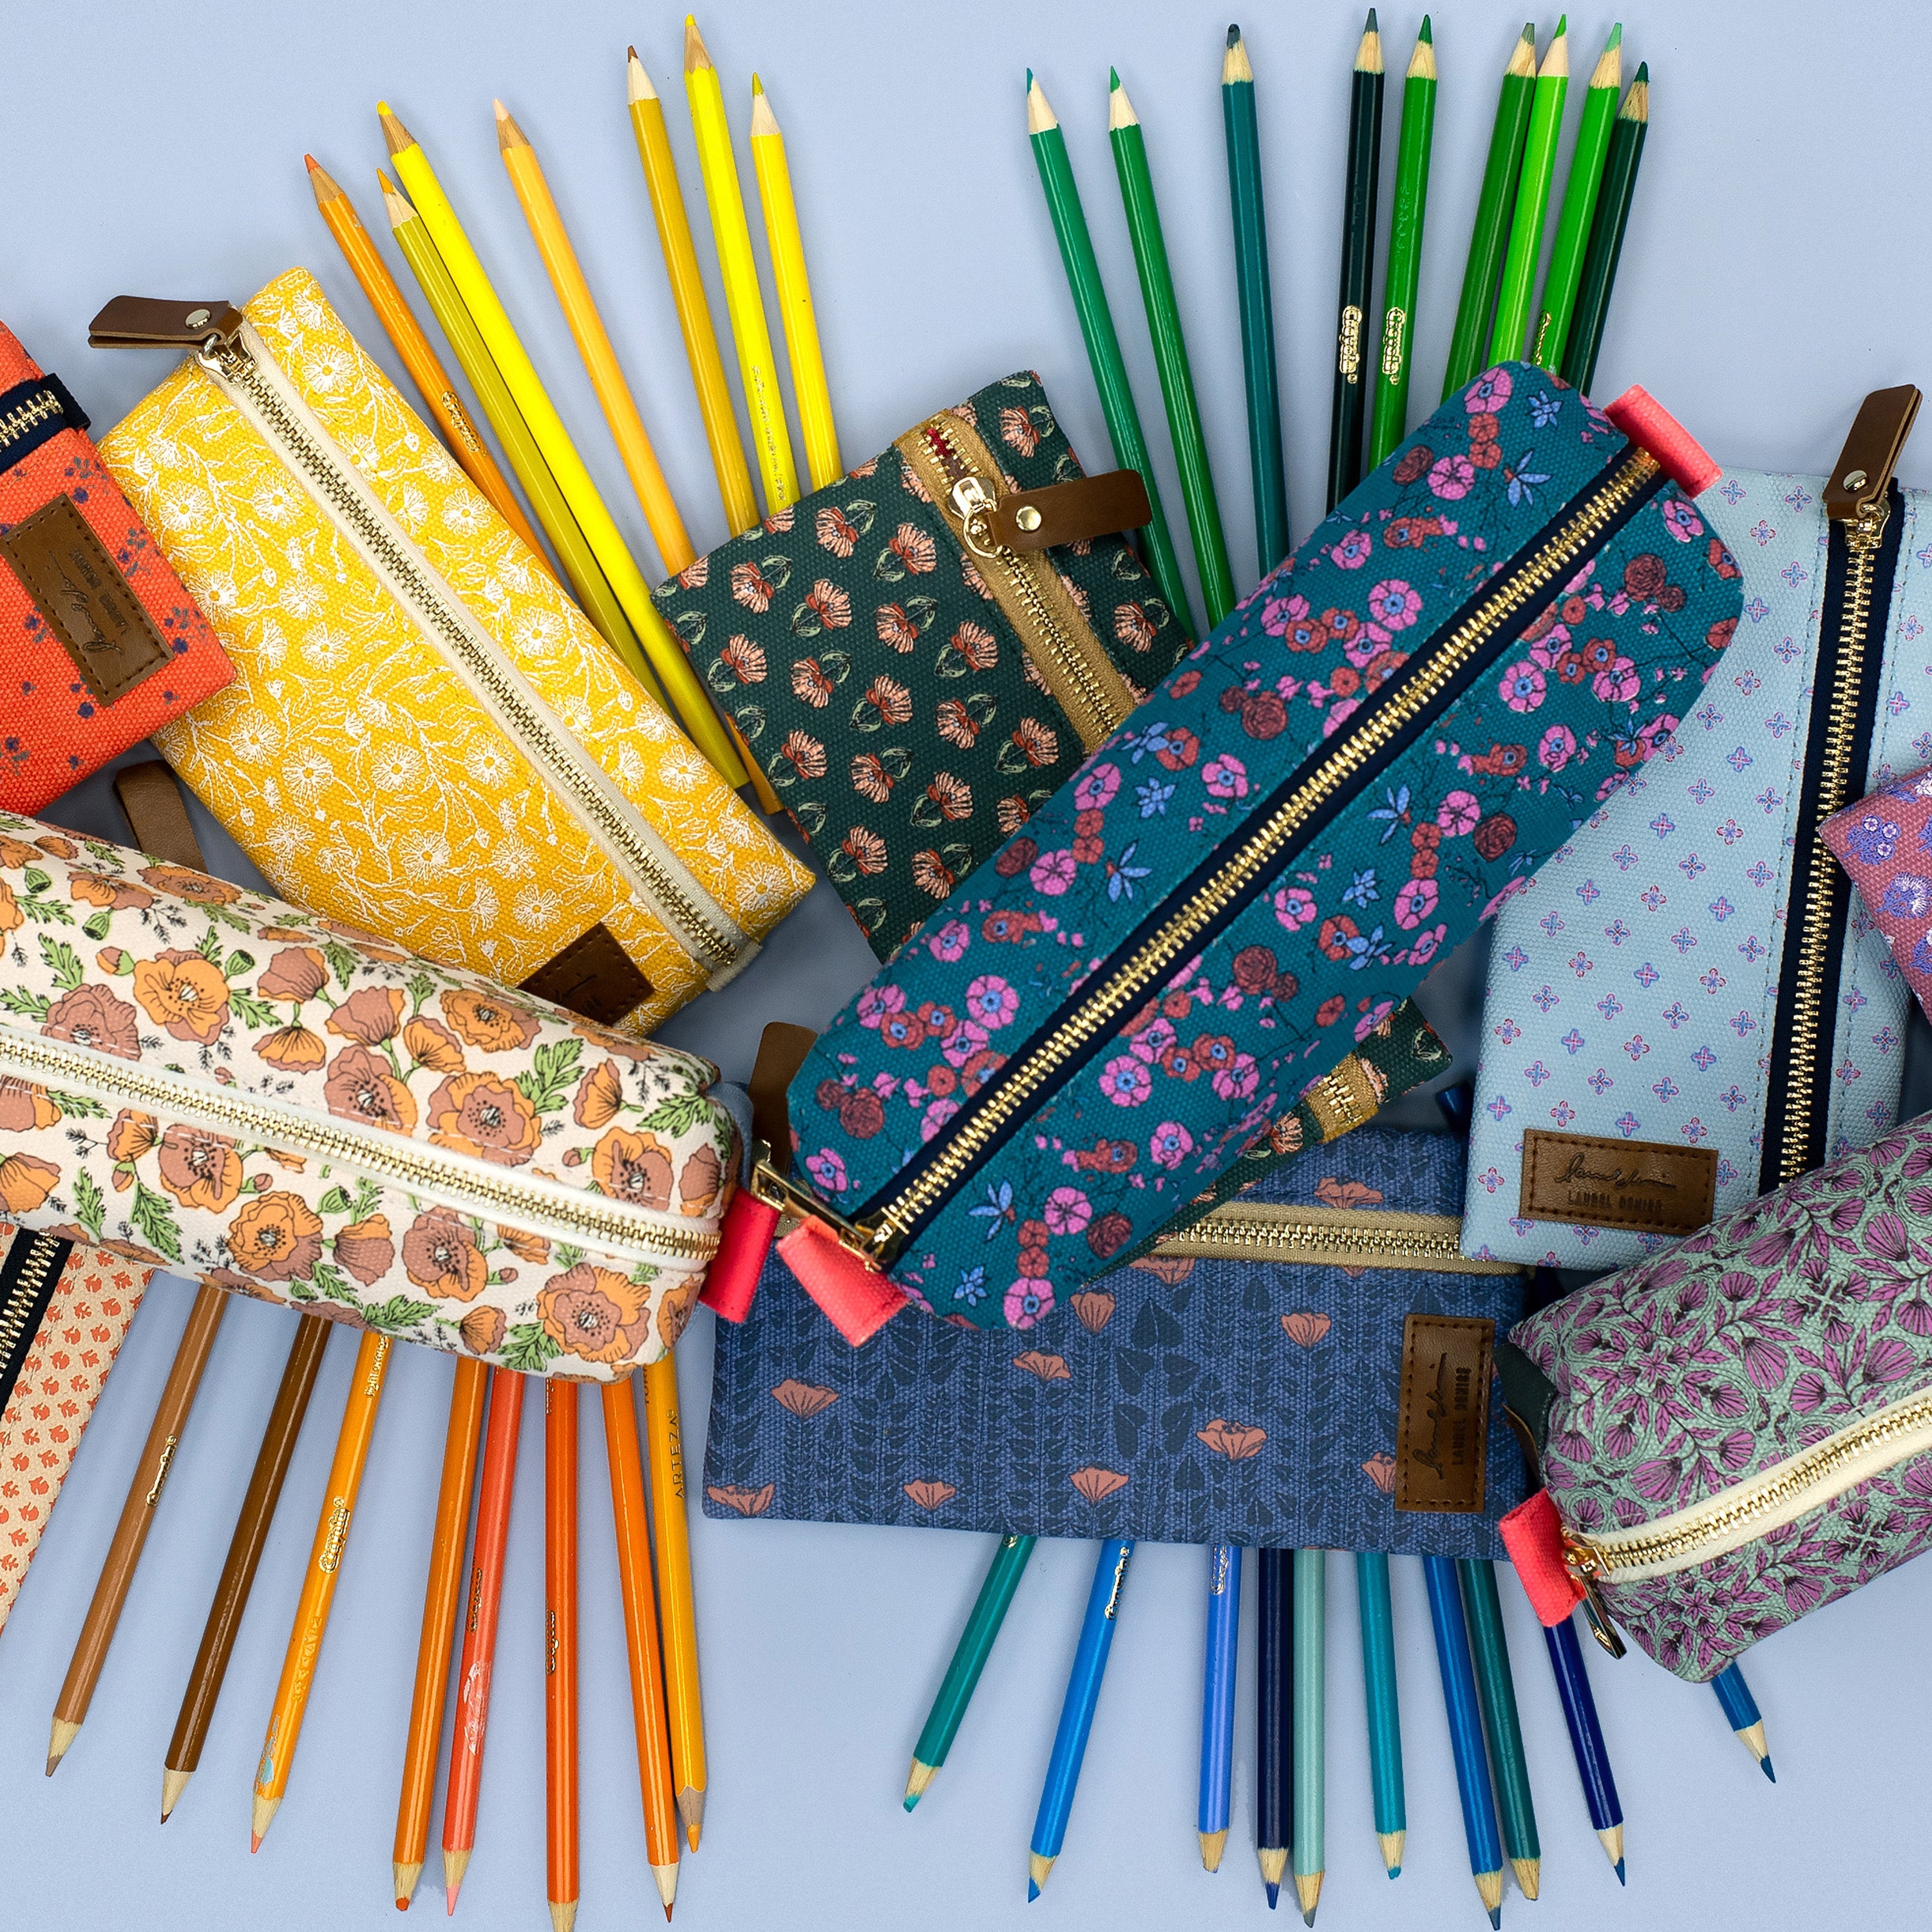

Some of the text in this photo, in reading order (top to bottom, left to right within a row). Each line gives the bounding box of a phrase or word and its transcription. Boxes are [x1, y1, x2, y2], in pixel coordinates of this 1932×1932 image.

[1382, 307, 1406, 374] Crayola
[440, 390, 480, 453] Crayola
[1567, 1191, 1611, 1209] LAUREL
[668, 1416, 687, 1499] ARTEZA
[1451, 1419, 1466, 1465] LAUREL
[319, 1508, 350, 1573] Crayola
